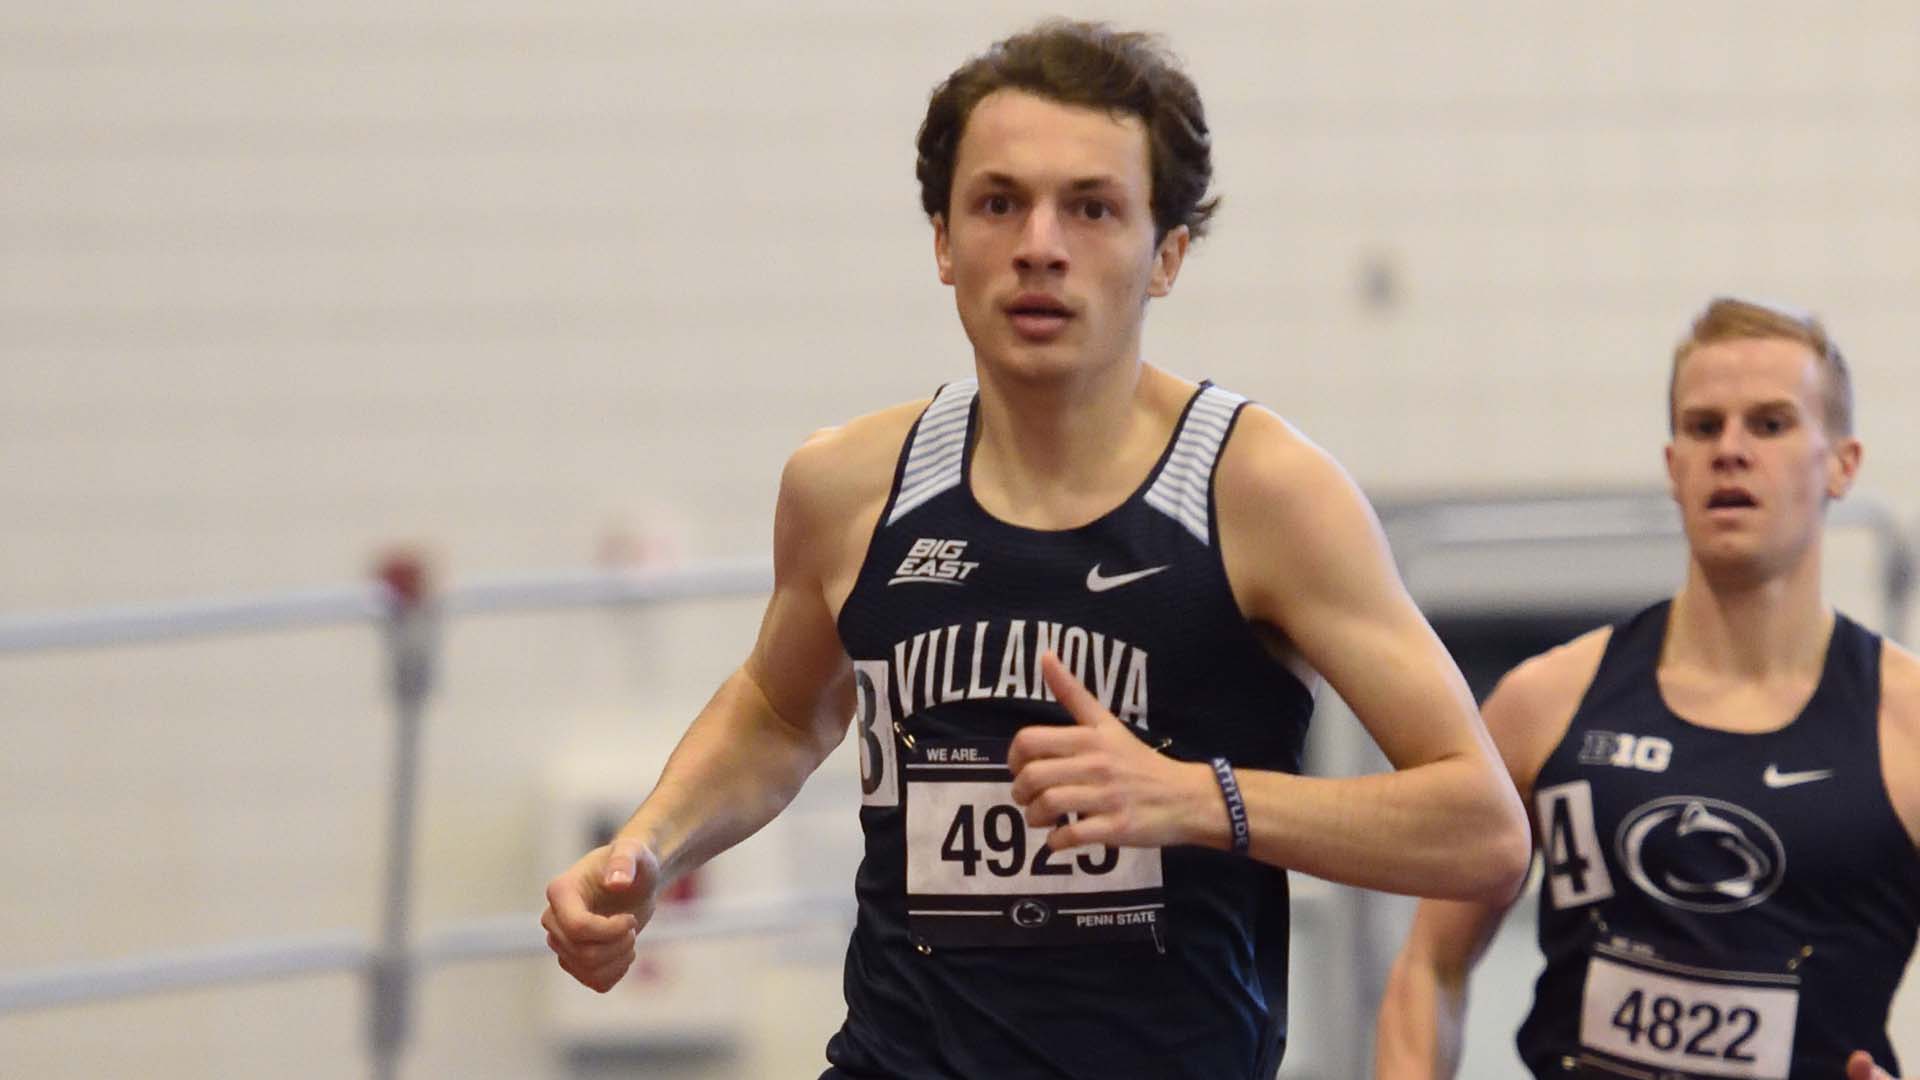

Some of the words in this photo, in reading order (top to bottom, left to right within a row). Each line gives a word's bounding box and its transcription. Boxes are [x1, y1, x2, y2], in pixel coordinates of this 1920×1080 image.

[907, 538, 968, 557] BIG
[896, 558, 980, 580] EAST
[894, 619, 1149, 731] VILLANOVA
[926, 747, 948, 761] WE
[1551, 796, 1590, 894] 4
[1076, 913, 1113, 927] PENN
[1116, 911, 1156, 925] STATE
[1612, 988, 1760, 1063] 4822
